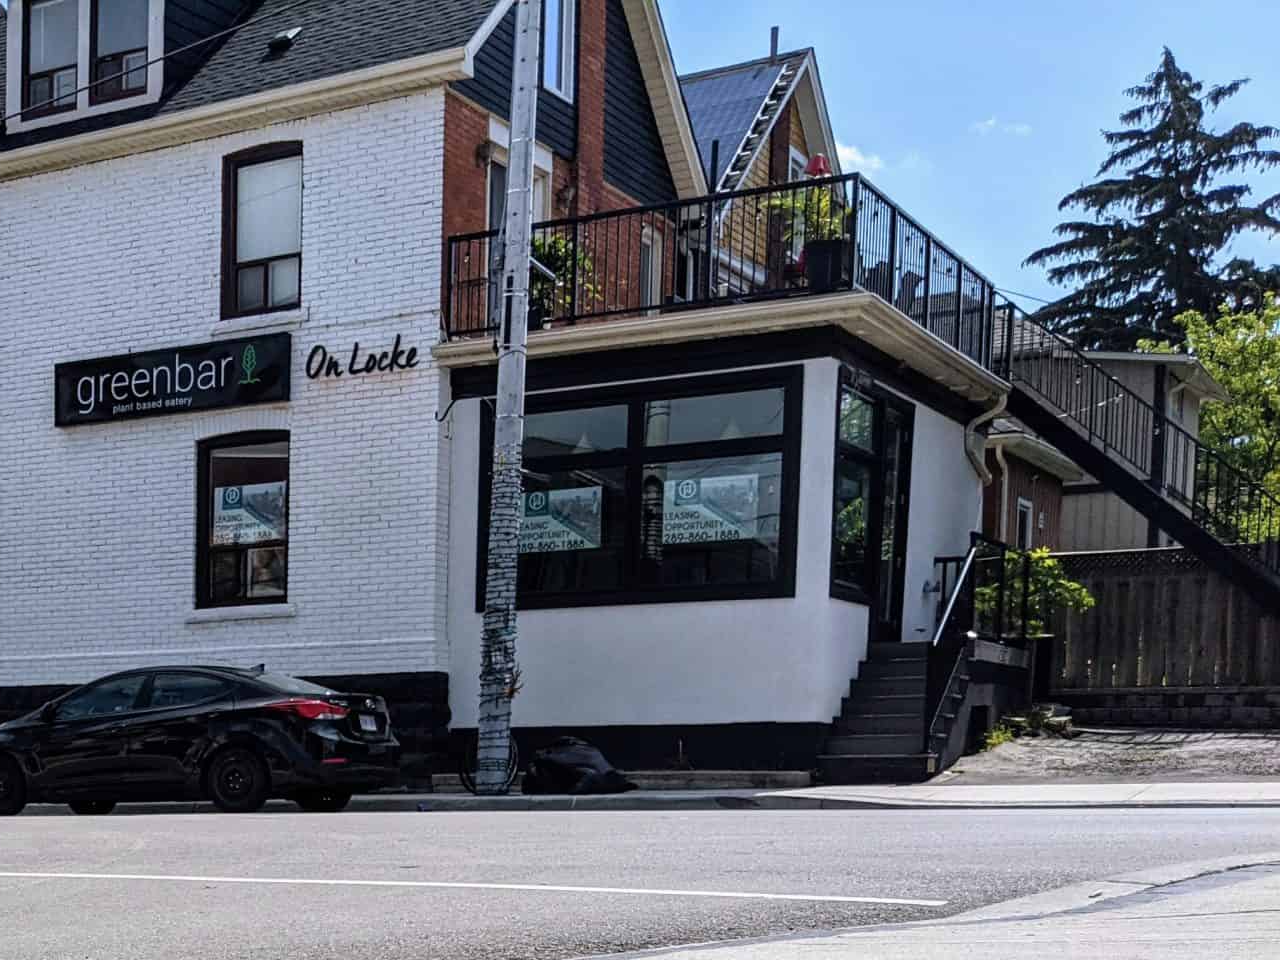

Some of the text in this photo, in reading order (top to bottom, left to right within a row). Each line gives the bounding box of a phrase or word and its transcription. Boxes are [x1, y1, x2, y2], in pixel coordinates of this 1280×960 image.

[306, 334, 419, 378] On Locke
[77, 353, 233, 414] greenbar
[113, 397, 193, 414] plant based eatery
[663, 511, 701, 521] LEASING
[664, 520, 724, 532] OPPORTUNITY
[663, 530, 741, 544] 289-860-1888
